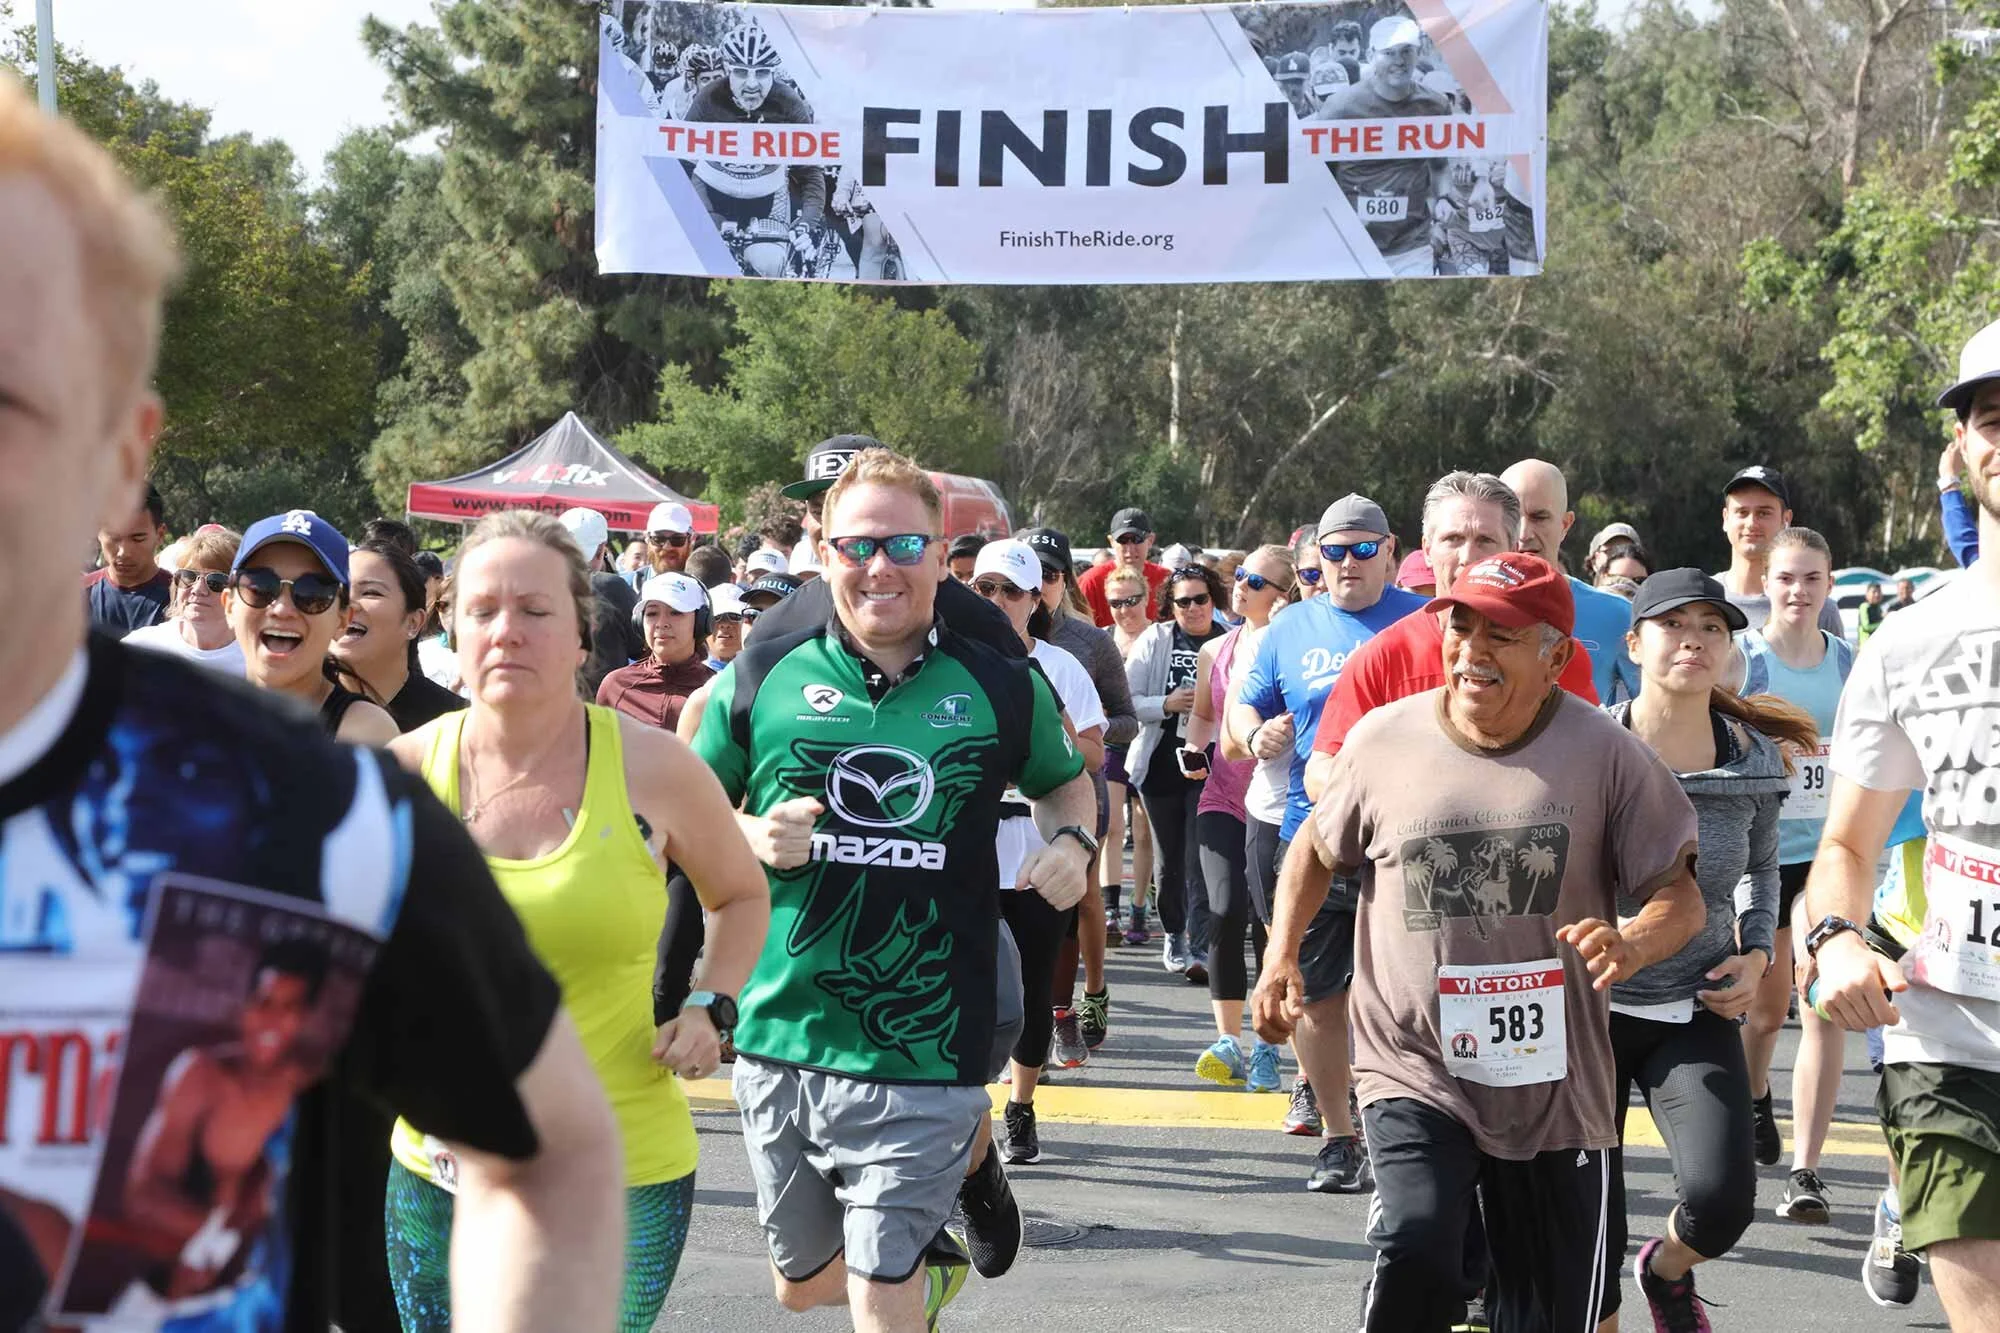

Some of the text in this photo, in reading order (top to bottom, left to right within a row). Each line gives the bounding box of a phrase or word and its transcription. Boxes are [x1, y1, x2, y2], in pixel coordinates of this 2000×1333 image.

[659, 126, 840, 158] THE RIDE
[862, 101, 1289, 187] FINISH
[1302, 122, 1486, 154] THE RUN
[1366, 200, 1400, 215] 680
[1000, 231, 1174, 251] FinishTheRide.org
[1803, 765, 1825, 790] 39
[1531, 824, 1561, 840] 2008
[1455, 973, 1546, 994] VICTORY
[1488, 1002, 1545, 1044] 583
